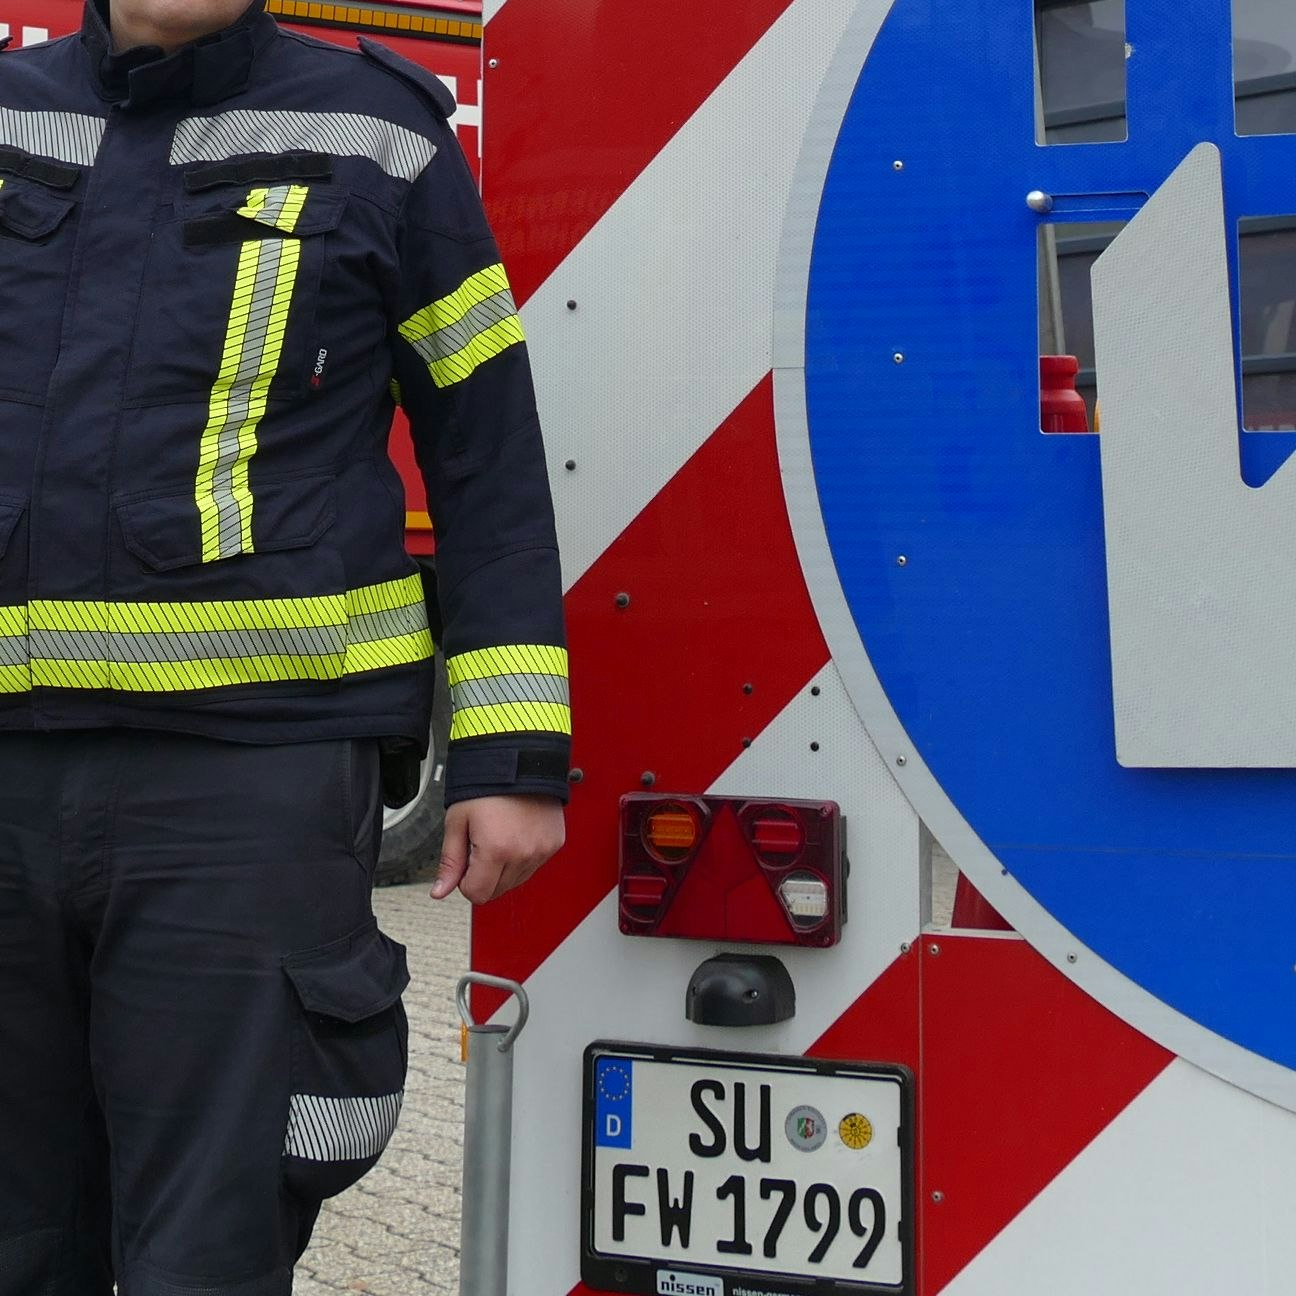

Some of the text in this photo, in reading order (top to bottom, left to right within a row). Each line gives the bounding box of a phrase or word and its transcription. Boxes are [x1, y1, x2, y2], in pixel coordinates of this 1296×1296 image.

[605, 1114, 622, 1137] D
[688, 1078, 772, 1163] SU
[611, 1163, 887, 1269] FW 1799
[660, 1274, 716, 1296] nissen
